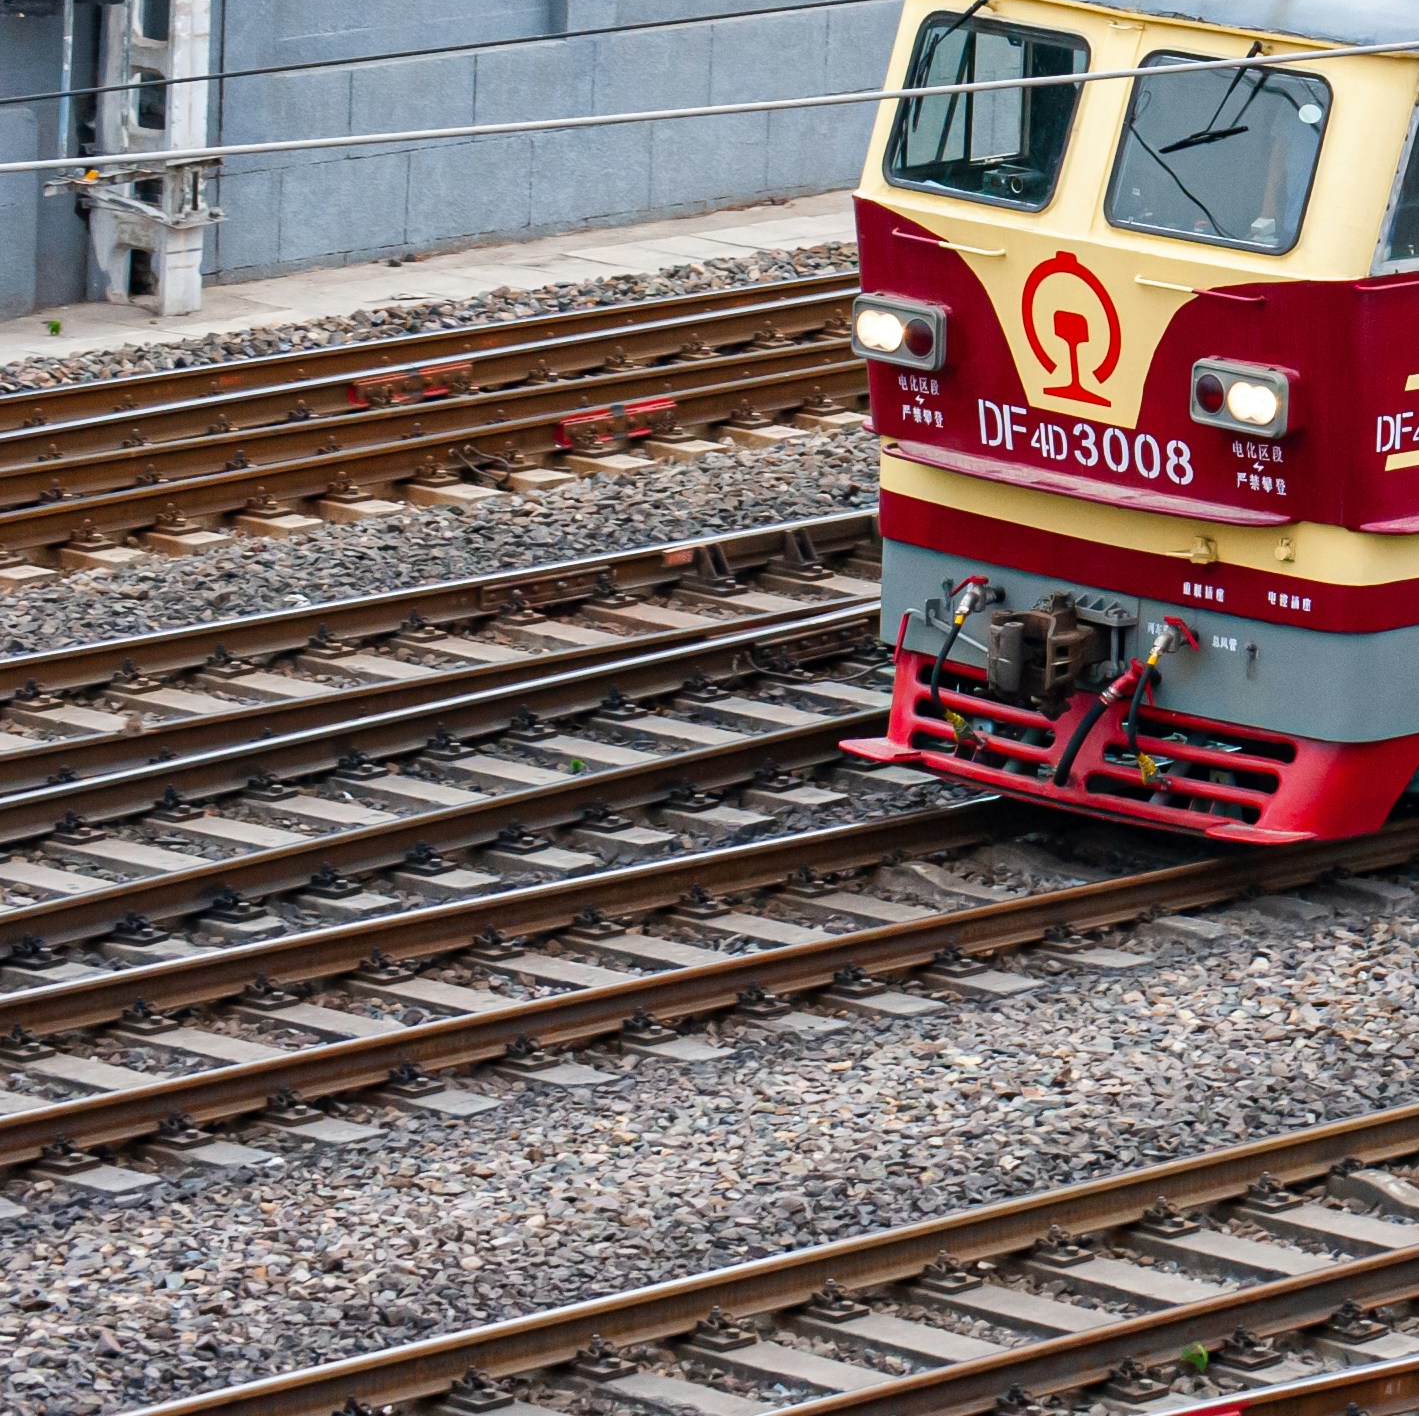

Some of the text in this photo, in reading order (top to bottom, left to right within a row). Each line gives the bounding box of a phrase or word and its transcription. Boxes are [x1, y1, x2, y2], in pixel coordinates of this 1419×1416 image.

[898, 373, 940, 396] 电化区段
[902, 404, 944, 428] 严禁攀登
[1232, 440, 1284, 463] 电化区段
[1236, 471, 1287, 496] 严禁攀登
